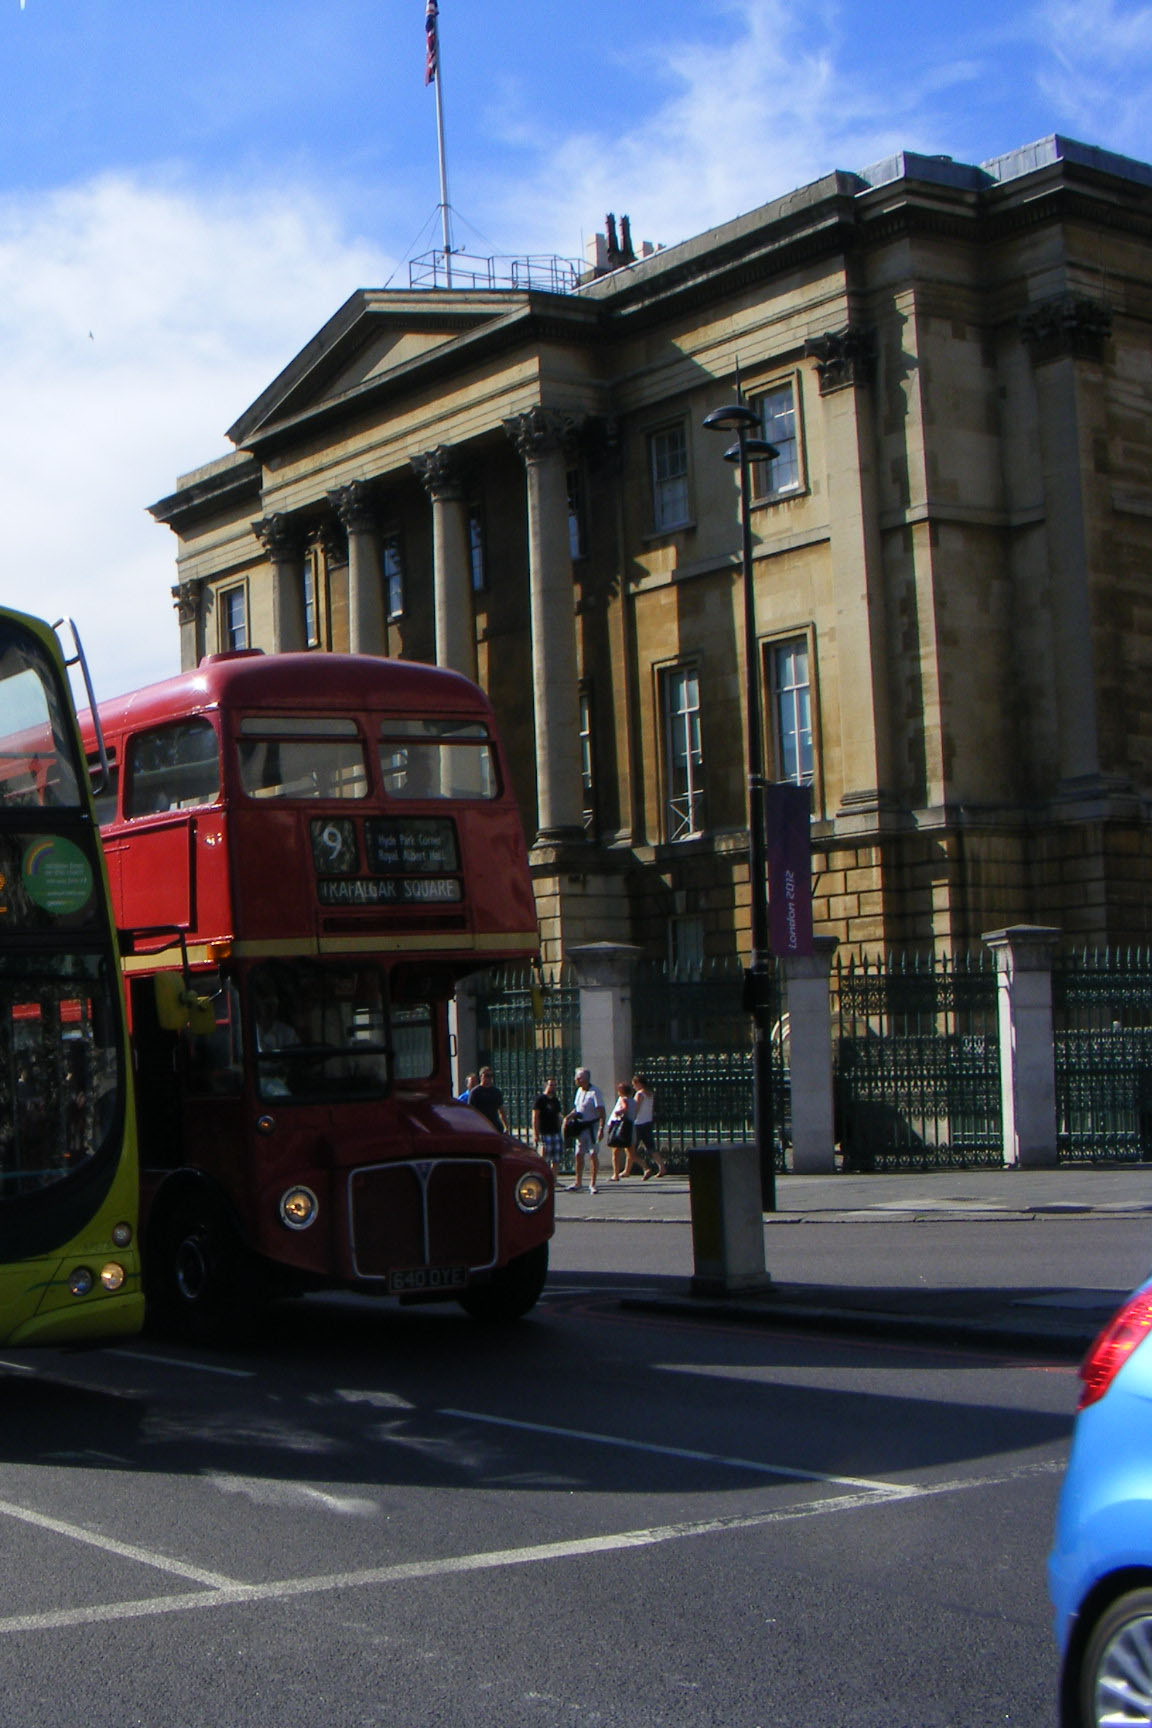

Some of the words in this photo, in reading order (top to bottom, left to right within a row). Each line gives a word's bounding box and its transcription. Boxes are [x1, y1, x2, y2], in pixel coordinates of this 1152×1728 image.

[322, 826, 343, 860] 9
[399, 832, 415, 845] Park
[323, 879, 397, 897] TRAFALGAR
[403, 879, 454, 897] SQUARE
[785, 870, 795, 902] 2012
[785, 903, 797, 949] London
